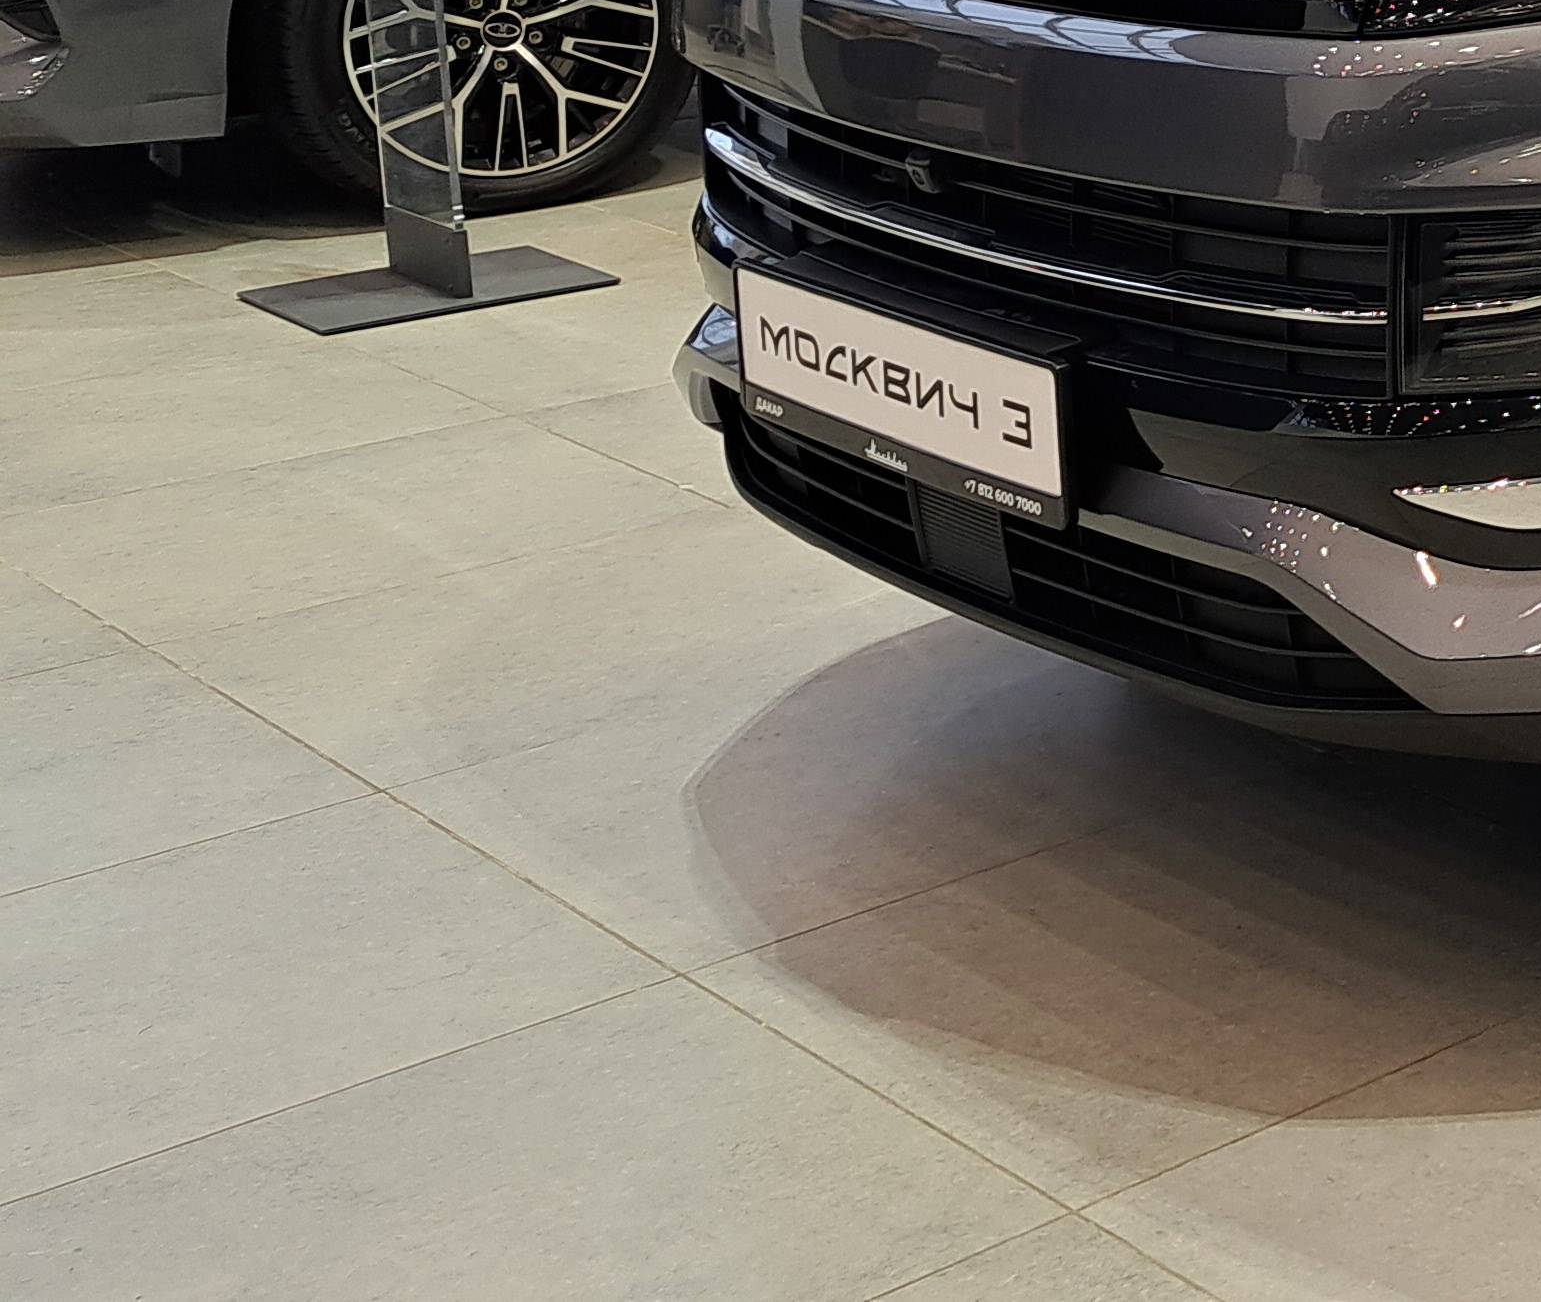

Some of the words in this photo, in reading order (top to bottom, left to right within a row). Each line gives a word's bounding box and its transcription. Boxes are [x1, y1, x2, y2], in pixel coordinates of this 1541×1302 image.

[759, 315, 980, 430] МОСКВИЧ
[1001, 398, 1033, 450] 3
[964, 479, 976, 494] +7
[977, 482, 994, 500] 812
[994, 488, 1014, 507] 600
[1015, 495, 1042, 516] 7000
